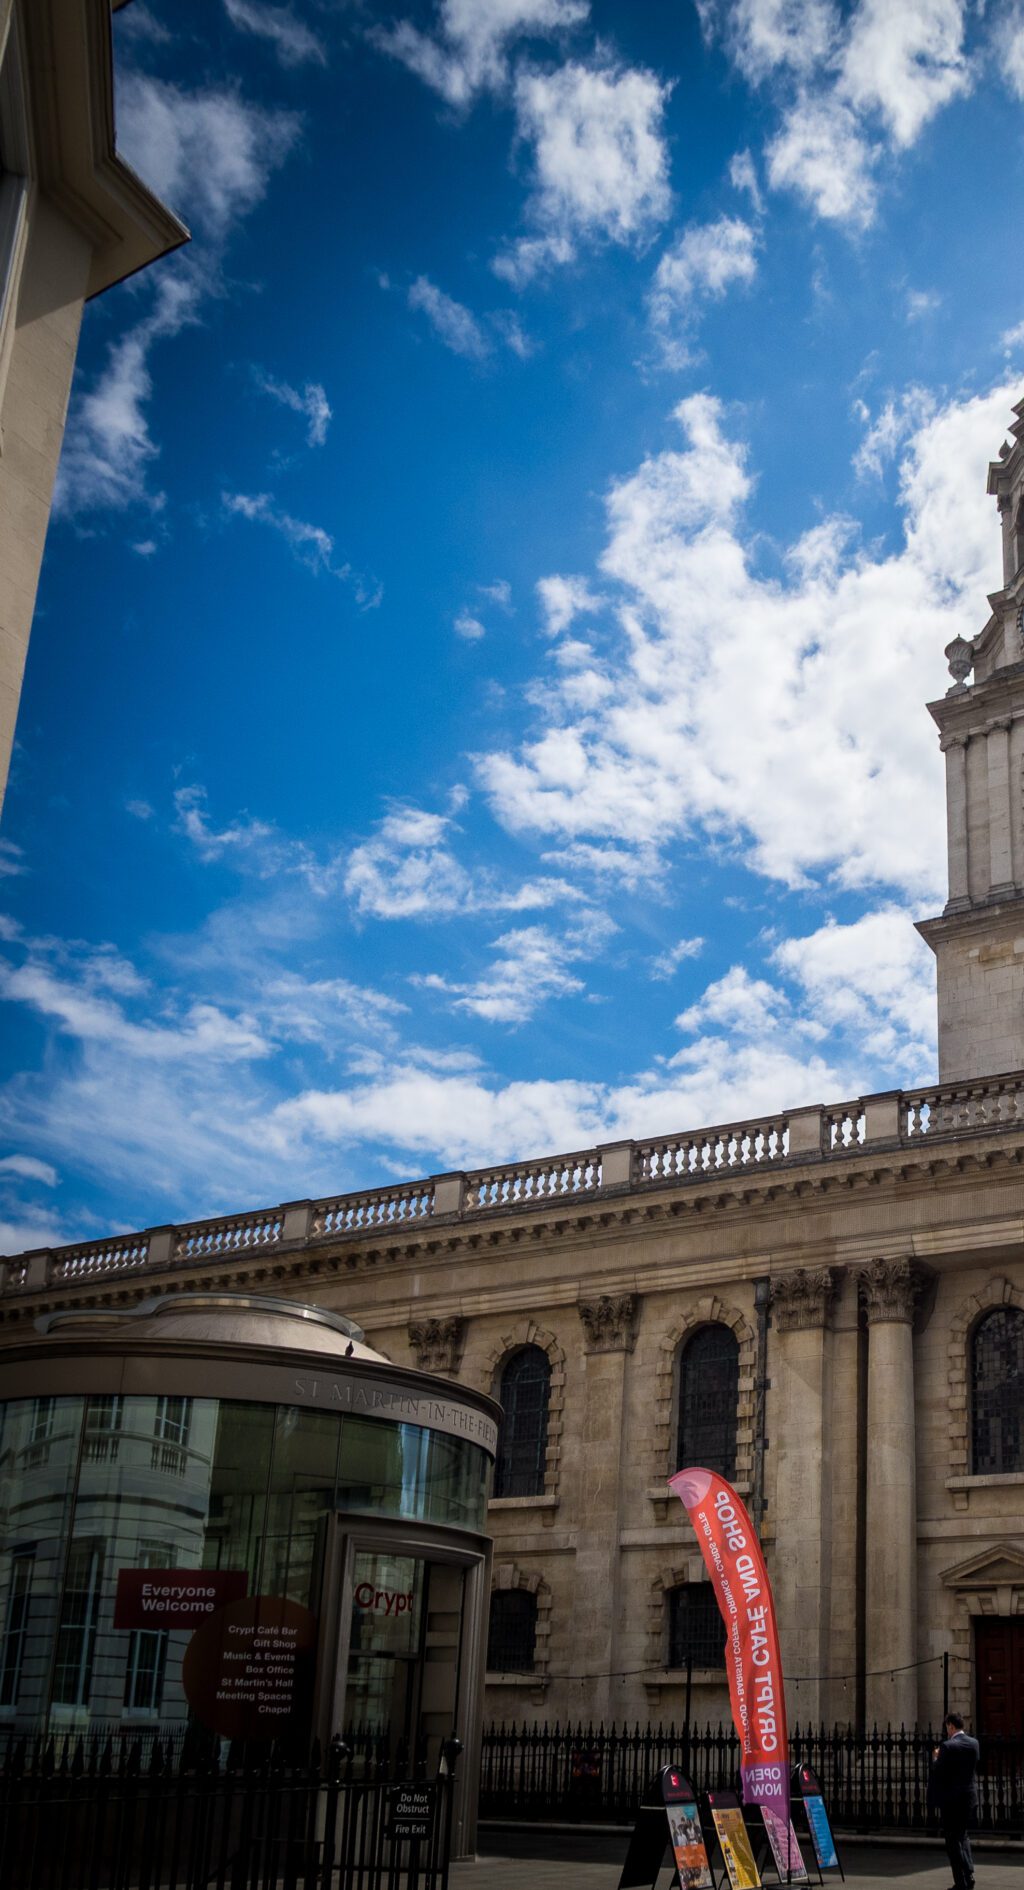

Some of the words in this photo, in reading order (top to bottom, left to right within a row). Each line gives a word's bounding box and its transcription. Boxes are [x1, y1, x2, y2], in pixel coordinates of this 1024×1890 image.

[295, 1379, 321, 1398] ST
[142, 1584, 216, 1599] Everyone
[356, 1583, 413, 1616] Crypt
[142, 1599, 215, 1612] Welcome
[228, 1625, 254, 1635] Crypt
[257, 1625, 279, 1634] Café
[281, 1627, 298, 1635] Bar
[253, 1639, 271, 1648] Gift
[272, 1640, 296, 1649] Shop
[223, 1652, 252, 1660] Music
[254, 1652, 262, 1660] &
[264, 1652, 296, 1661] Events
[246, 1665, 264, 1674] Box
[266, 1665, 294, 1674] Office
[221, 1678, 233, 1686] St
[234, 1679, 273, 1687] Martin's
[275, 1679, 293, 1687] Hall
[216, 1691, 255, 1701] Meeting
[258, 1692, 292, 1702] Spaces
[258, 1705, 291, 1714] Chapel
[400, 1793, 412, 1802] Do
[413, 1793, 427, 1803] Not
[396, 1803, 430, 1814] Obstruct
[395, 1824, 410, 1834] Fire
[411, 1824, 426, 1834] Exit
